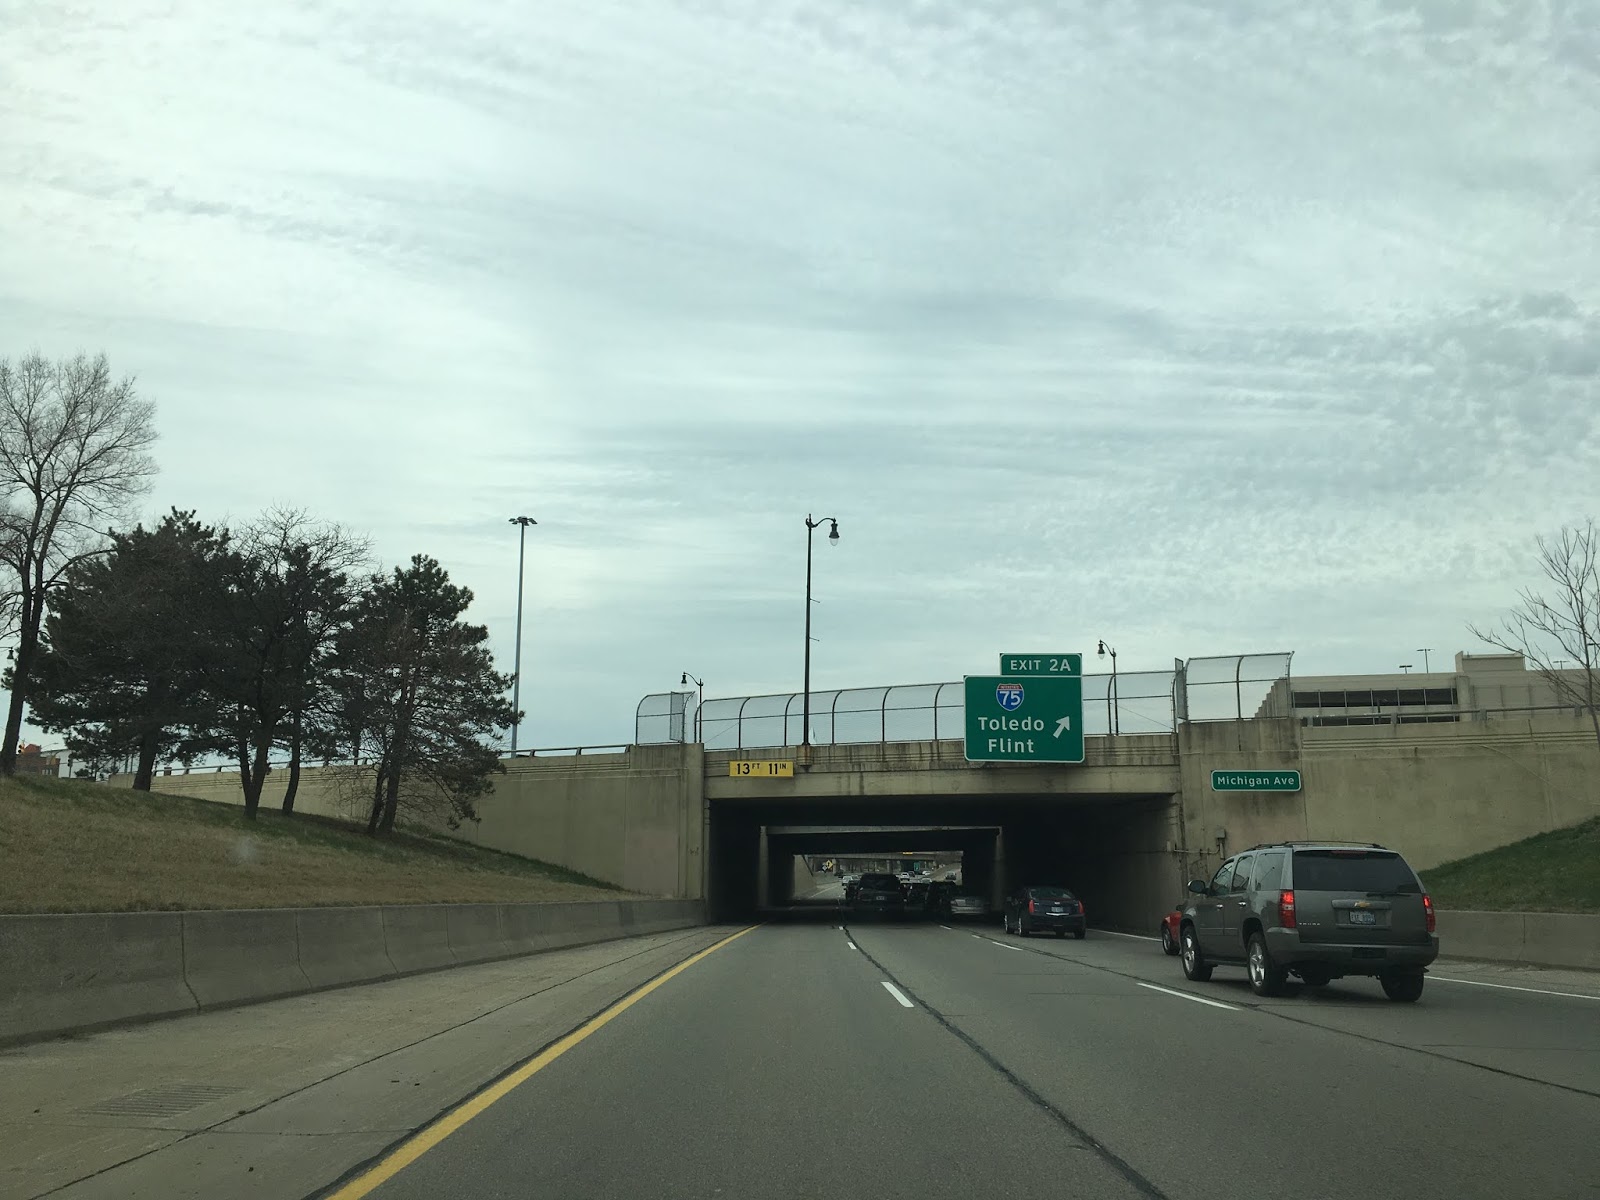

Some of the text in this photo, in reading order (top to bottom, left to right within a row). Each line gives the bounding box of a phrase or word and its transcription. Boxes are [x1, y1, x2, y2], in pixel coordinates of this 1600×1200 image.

[1010, 658, 1071, 671] EXIT 2A
[999, 691, 1021, 705] 75
[977, 716, 1044, 731] Toledo
[988, 738, 1034, 753] Flint
[1217, 776, 1295, 787] Michigan Ave
